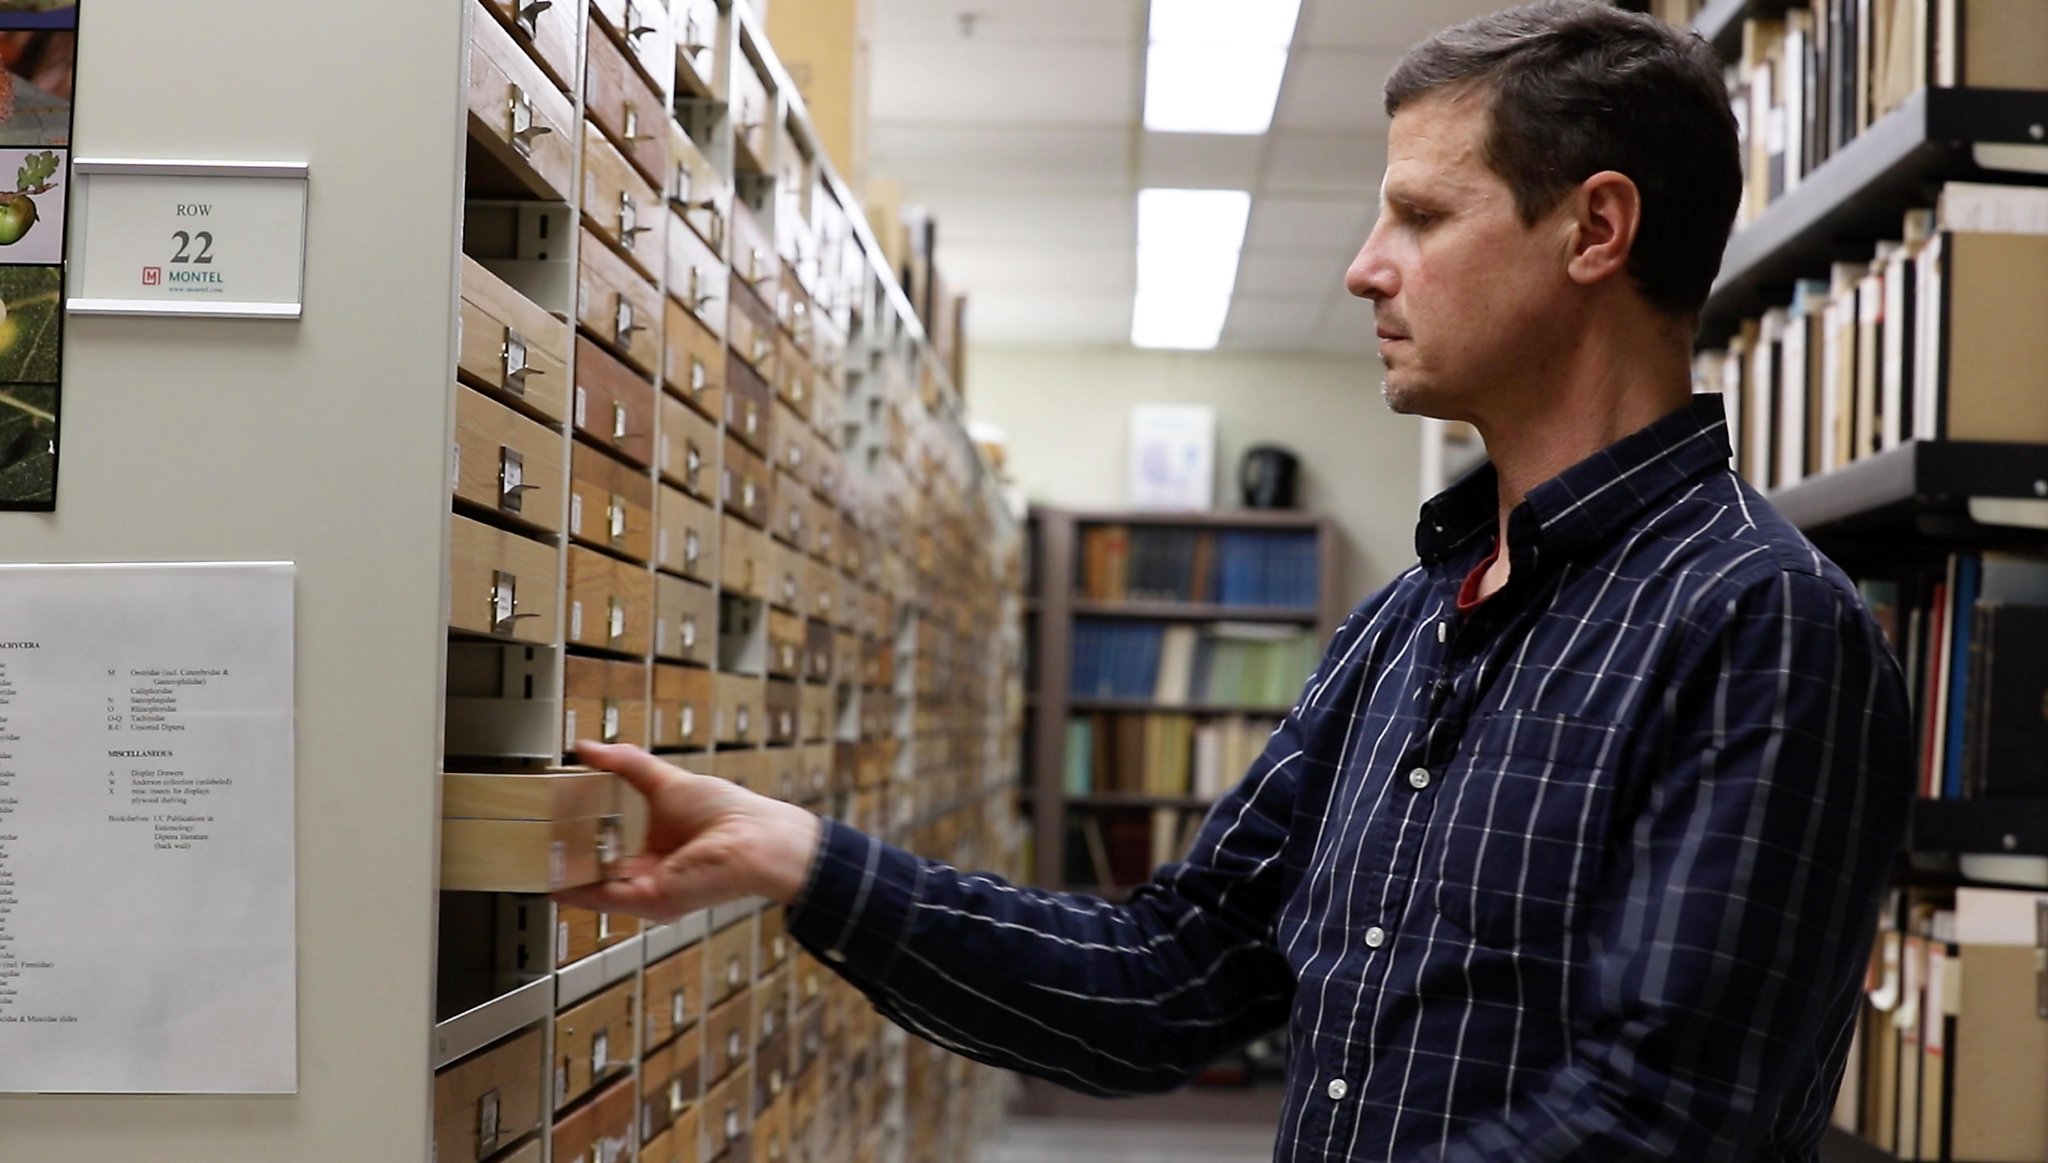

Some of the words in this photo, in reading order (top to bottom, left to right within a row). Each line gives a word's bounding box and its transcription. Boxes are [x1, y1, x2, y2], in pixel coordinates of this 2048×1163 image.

[176, 204, 212, 216] ROW
[170, 230, 214, 264] 22
[168, 271, 223, 283] MONTEL
